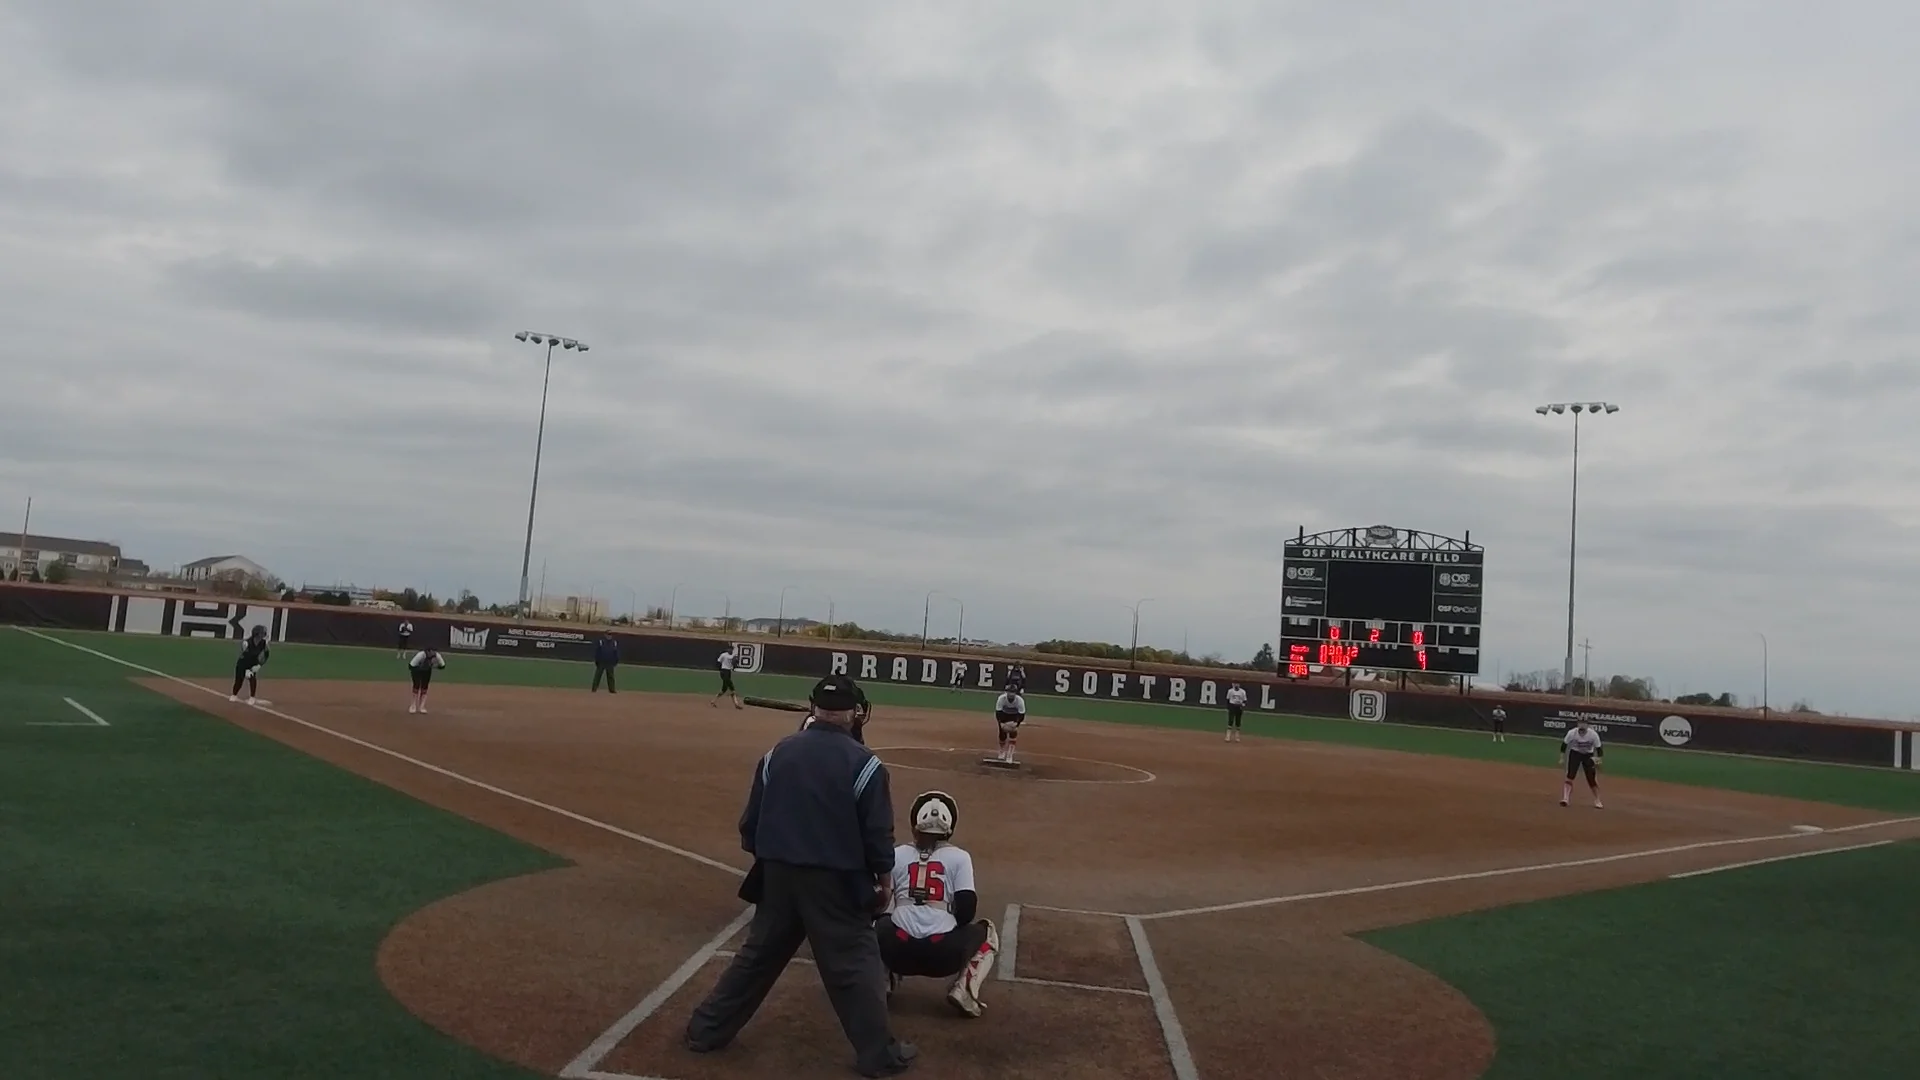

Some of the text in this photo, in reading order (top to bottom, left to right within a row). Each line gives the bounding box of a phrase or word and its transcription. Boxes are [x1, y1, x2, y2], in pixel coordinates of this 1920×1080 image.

[1302, 549, 1460, 563] OSF HEALTHCARE FIELD
[1451, 573, 1470, 583] OSF
[831, 652, 1275, 709] BRADE SOFTBAL
[1663, 729, 1691, 739] NCAA
[908, 861, 945, 901] 16
